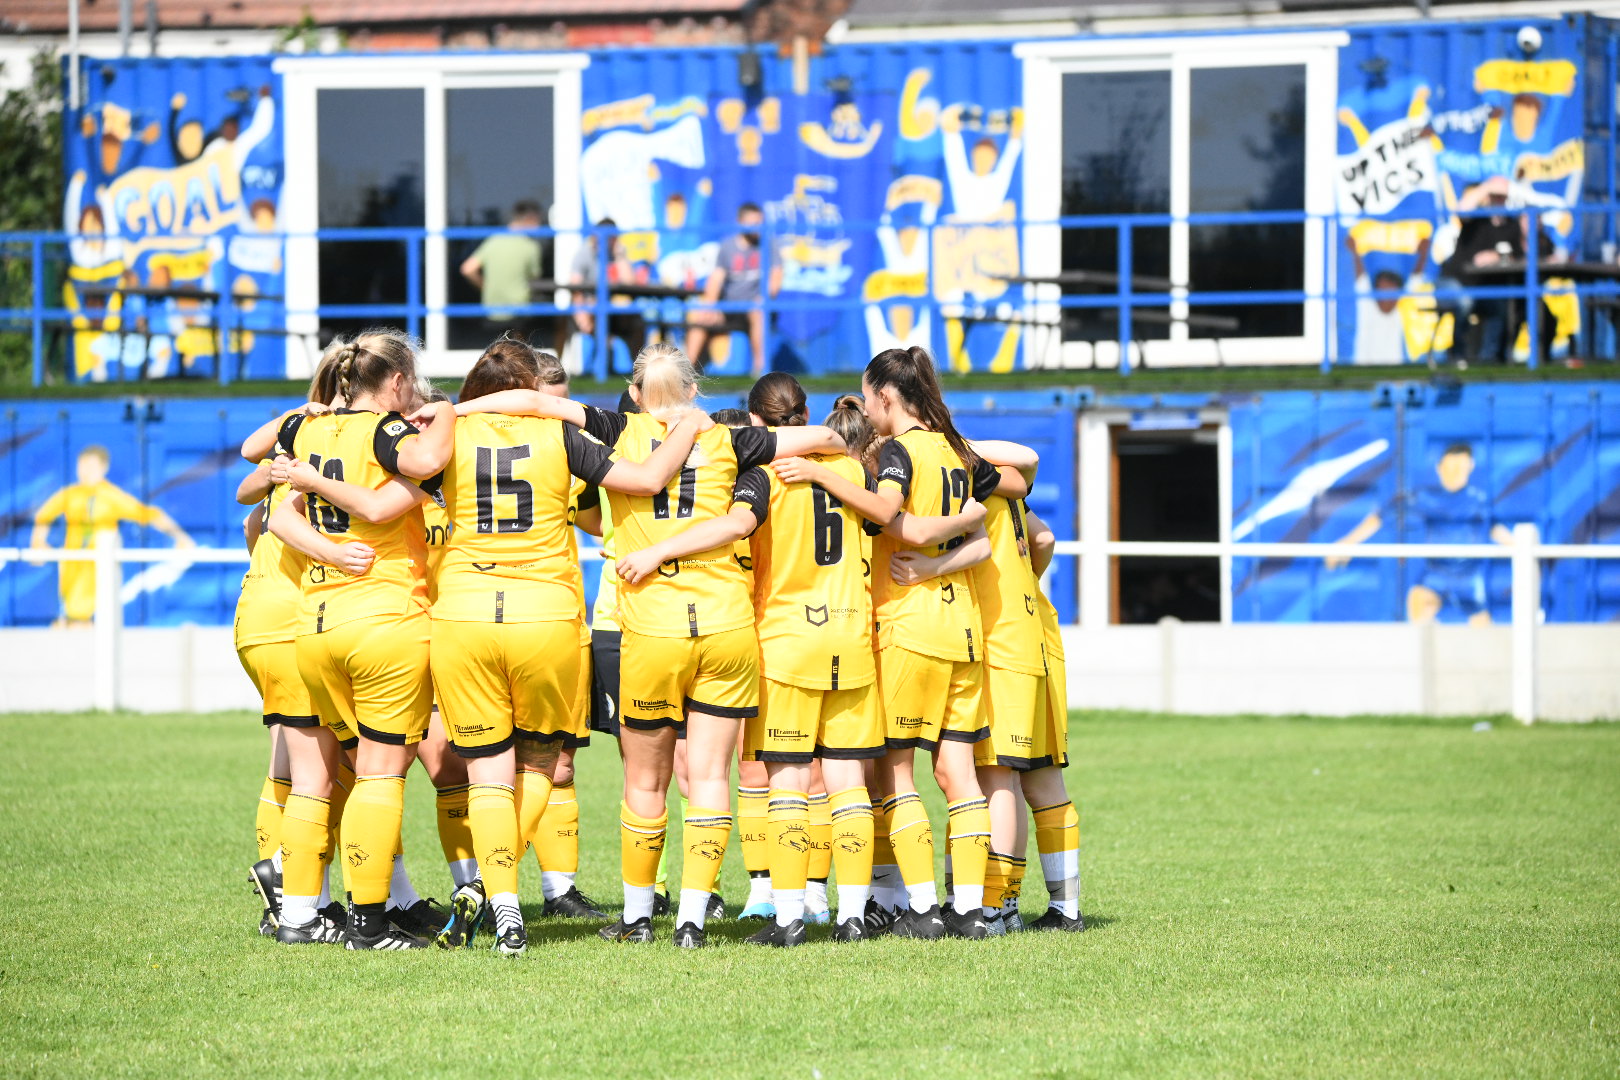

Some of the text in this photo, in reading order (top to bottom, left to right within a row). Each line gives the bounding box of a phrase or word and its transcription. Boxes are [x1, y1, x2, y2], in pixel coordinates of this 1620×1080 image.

[114, 163, 236, 239] GOAL
[1351, 160, 1423, 210] VICS
[475, 444, 534, 534] 15
[812, 482, 843, 566] 6
